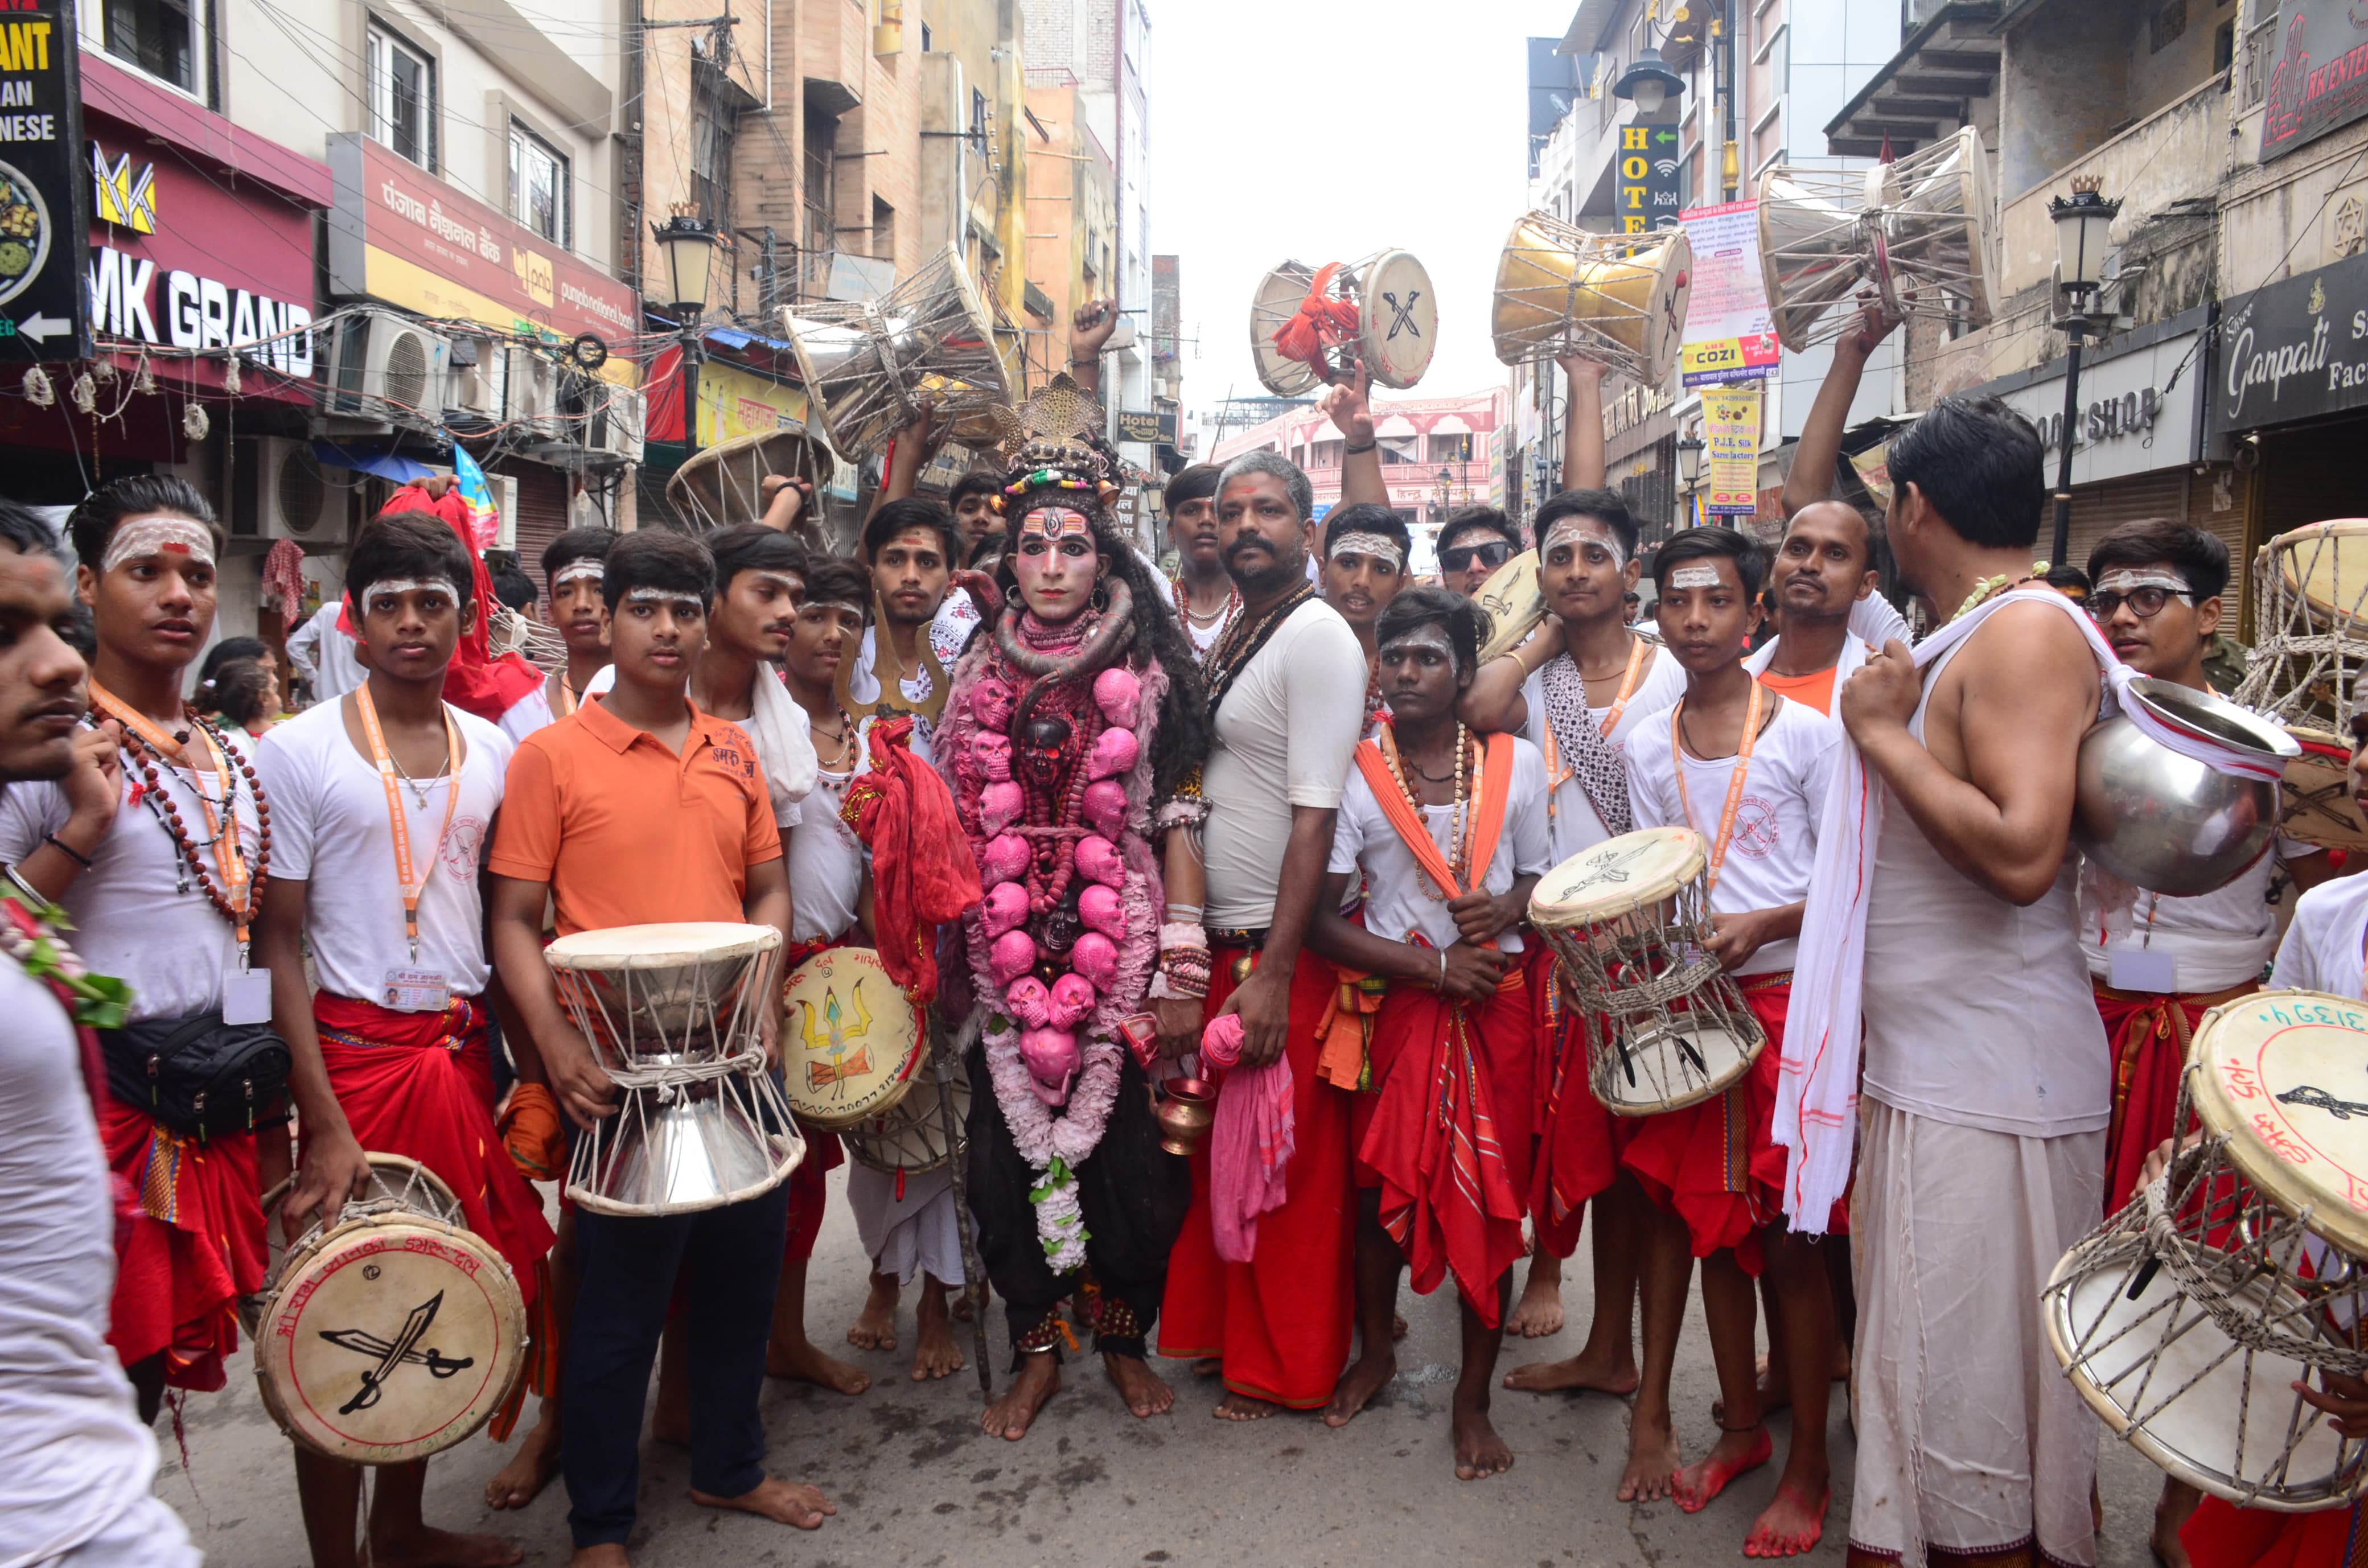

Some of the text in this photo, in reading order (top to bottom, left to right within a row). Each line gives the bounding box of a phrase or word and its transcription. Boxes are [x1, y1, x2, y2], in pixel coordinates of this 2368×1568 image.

[2307, 64, 2328, 102] RK
[2328, 42, 2368, 91] ENTE
[1622, 127, 1649, 258] HOTE
[381, 179, 426, 226] पंजाब
[429, 199, 476, 252] नैशनल
[479, 225, 500, 263] बैंक
[531, 266, 551, 294] pnb
[90, 246, 313, 378] MK GRAND
[561, 282, 589, 310] punjab
[589, 297, 618, 324] national
[2226, 302, 2253, 343] Shree
[1696, 349, 1735, 363] COZI
[2227, 315, 2331, 418] Ganpati
[2328, 361, 2368, 391] Fac
[1120, 414, 1160, 427] Hotel
[2088, 386, 2163, 440] SHOP
[1738, 439, 1752, 447] Silk
